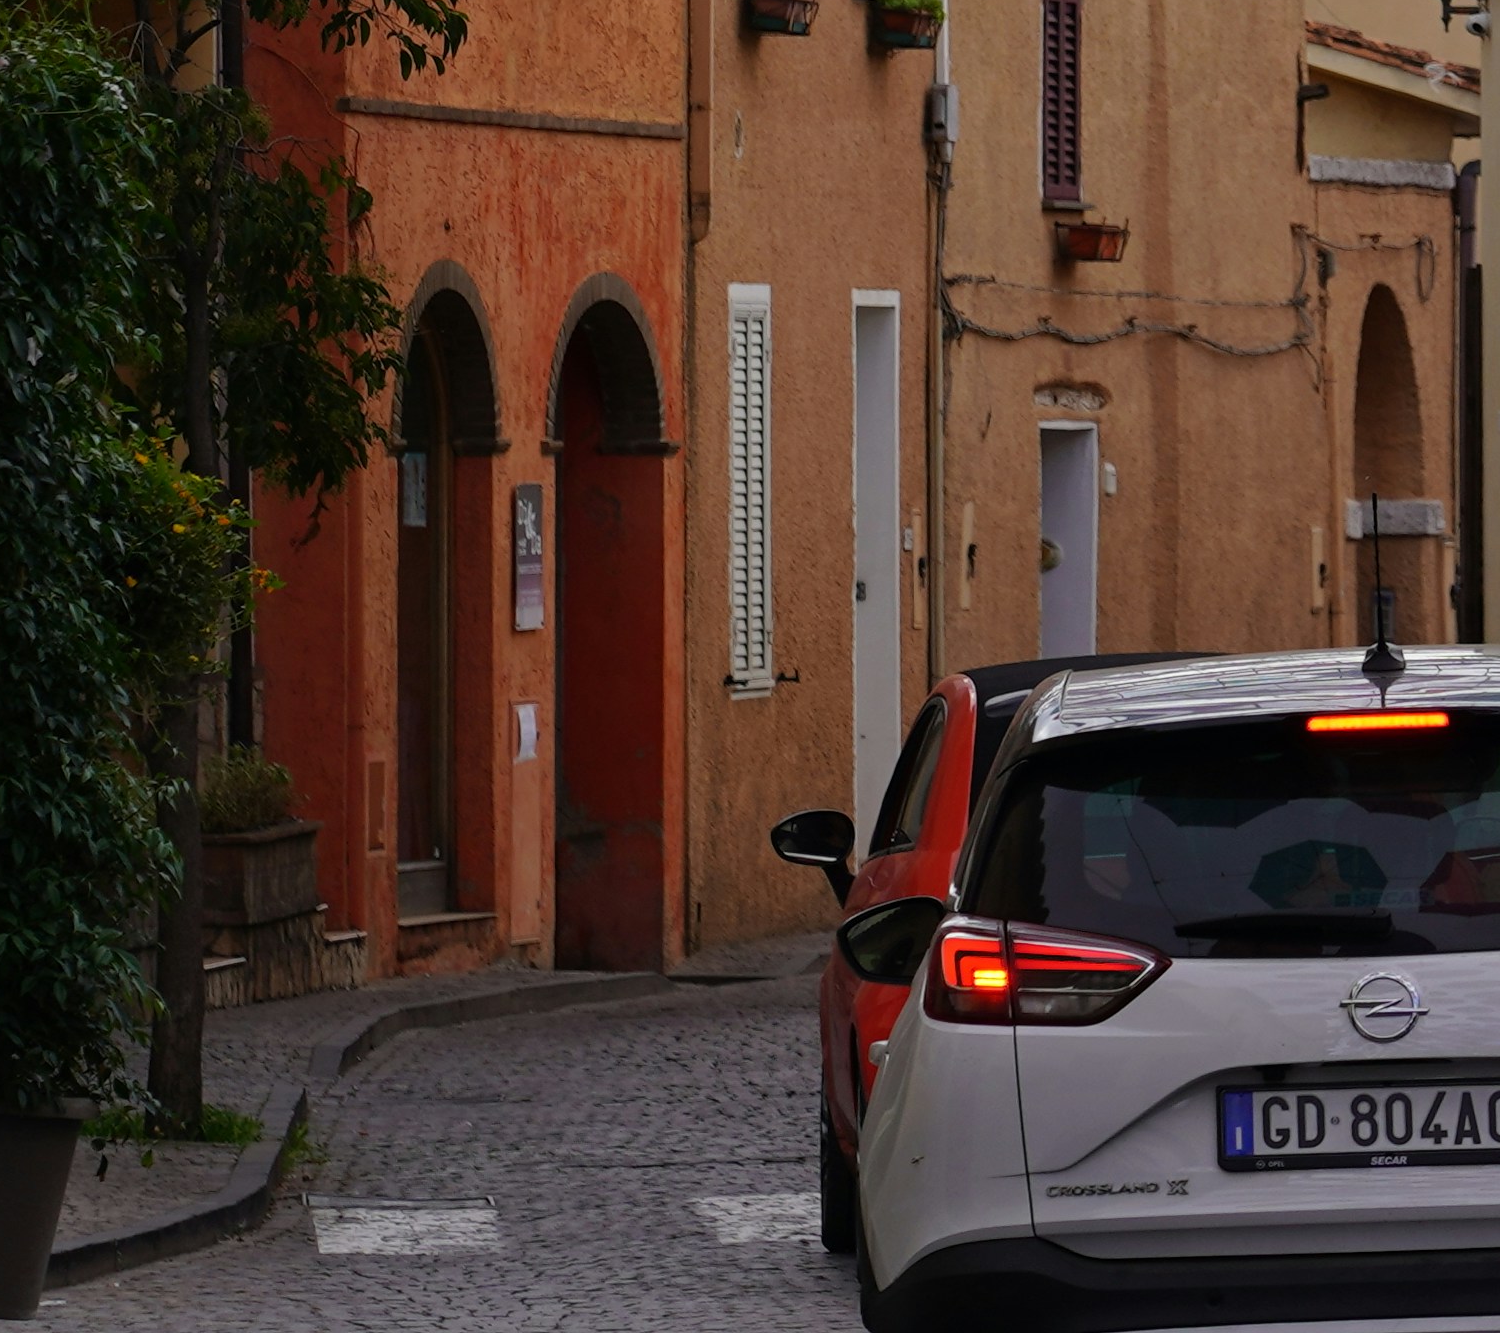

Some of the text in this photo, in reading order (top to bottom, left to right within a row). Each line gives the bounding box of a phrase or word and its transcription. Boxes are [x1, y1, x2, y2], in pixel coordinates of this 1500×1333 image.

[1261, 1094, 1326, 1150] GD
[1370, 1155, 1408, 1167] SECAR
[1045, 1179, 1190, 1199] CROSSLAND X
